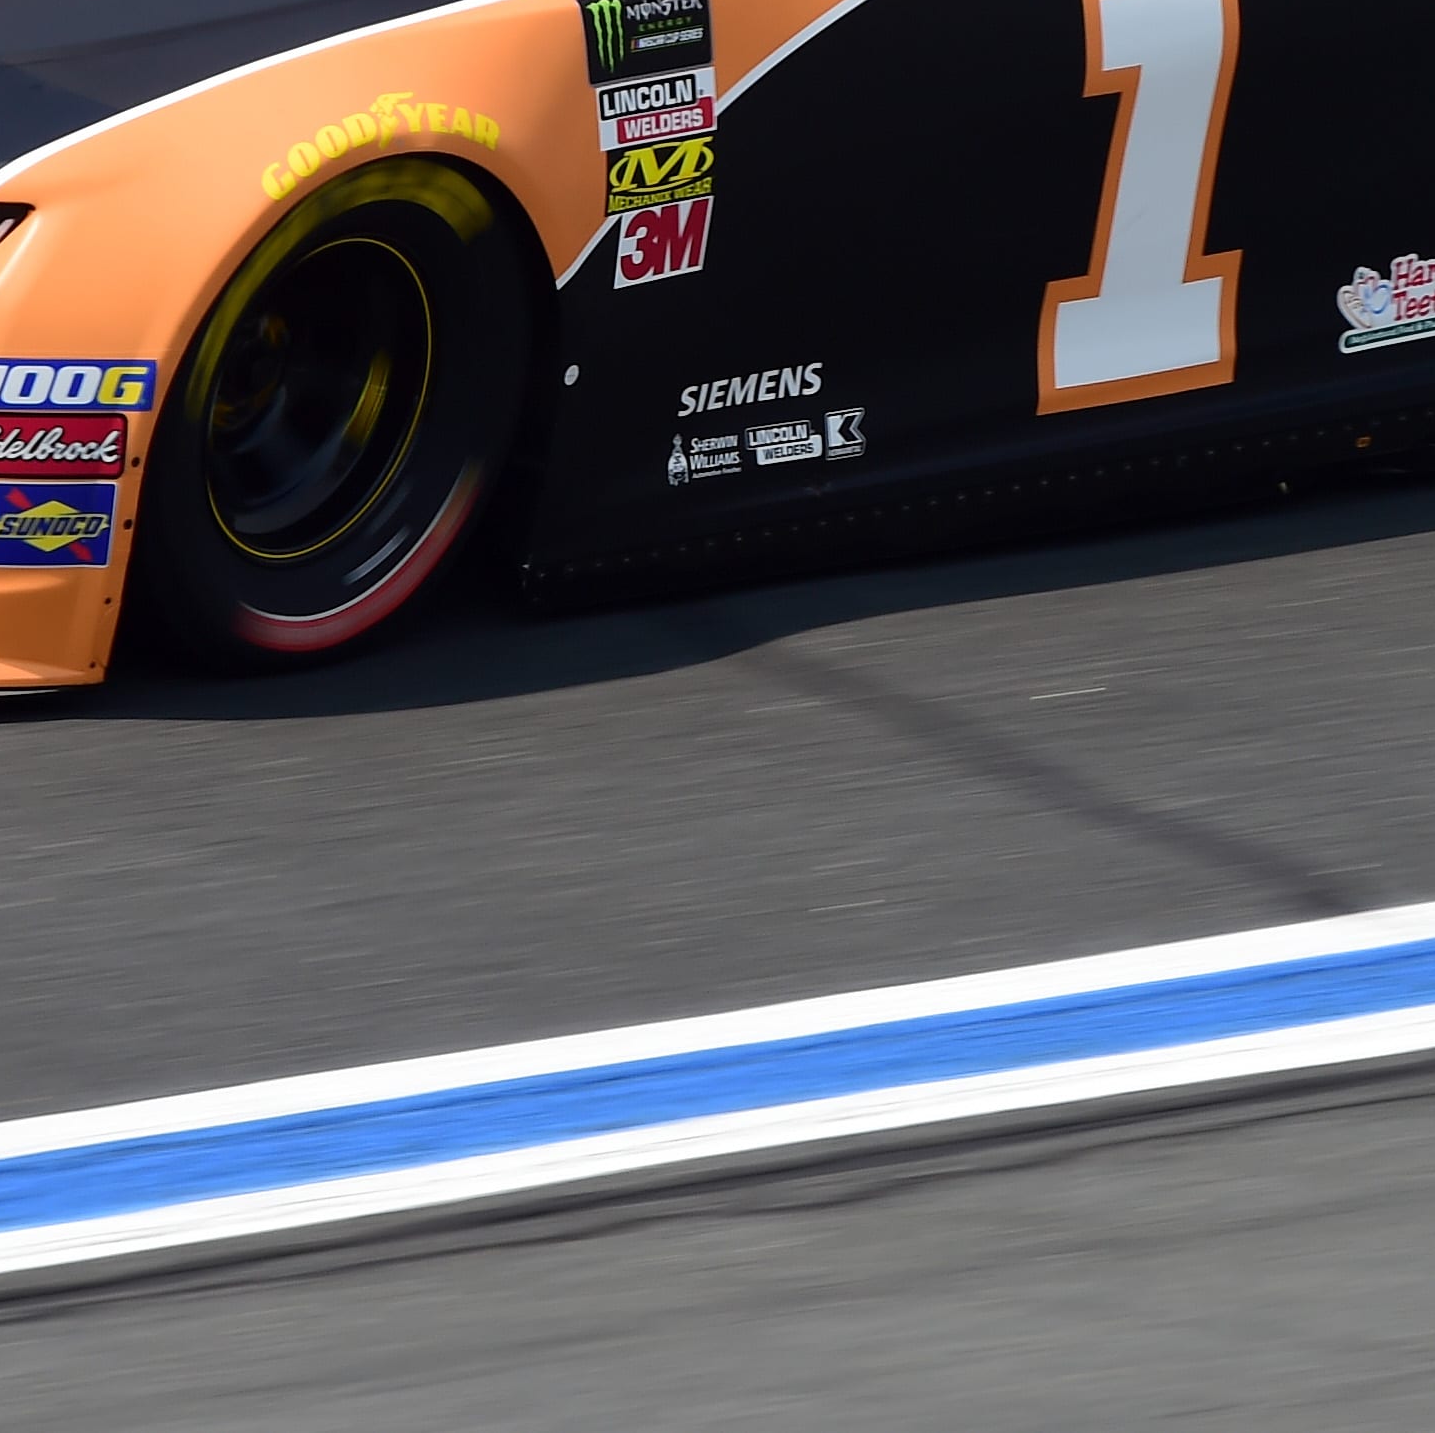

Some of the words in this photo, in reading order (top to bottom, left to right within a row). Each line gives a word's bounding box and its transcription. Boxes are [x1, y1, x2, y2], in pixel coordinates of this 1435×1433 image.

[602, 78, 694, 117] LINCOLN
[624, 108, 704, 139] WELDERS
[620, 198, 710, 281] 3M
[677, 362, 823, 417] SIEMENS
[748, 423, 808, 446] LINCOLN
[764, 442, 815, 460] WELDERS
